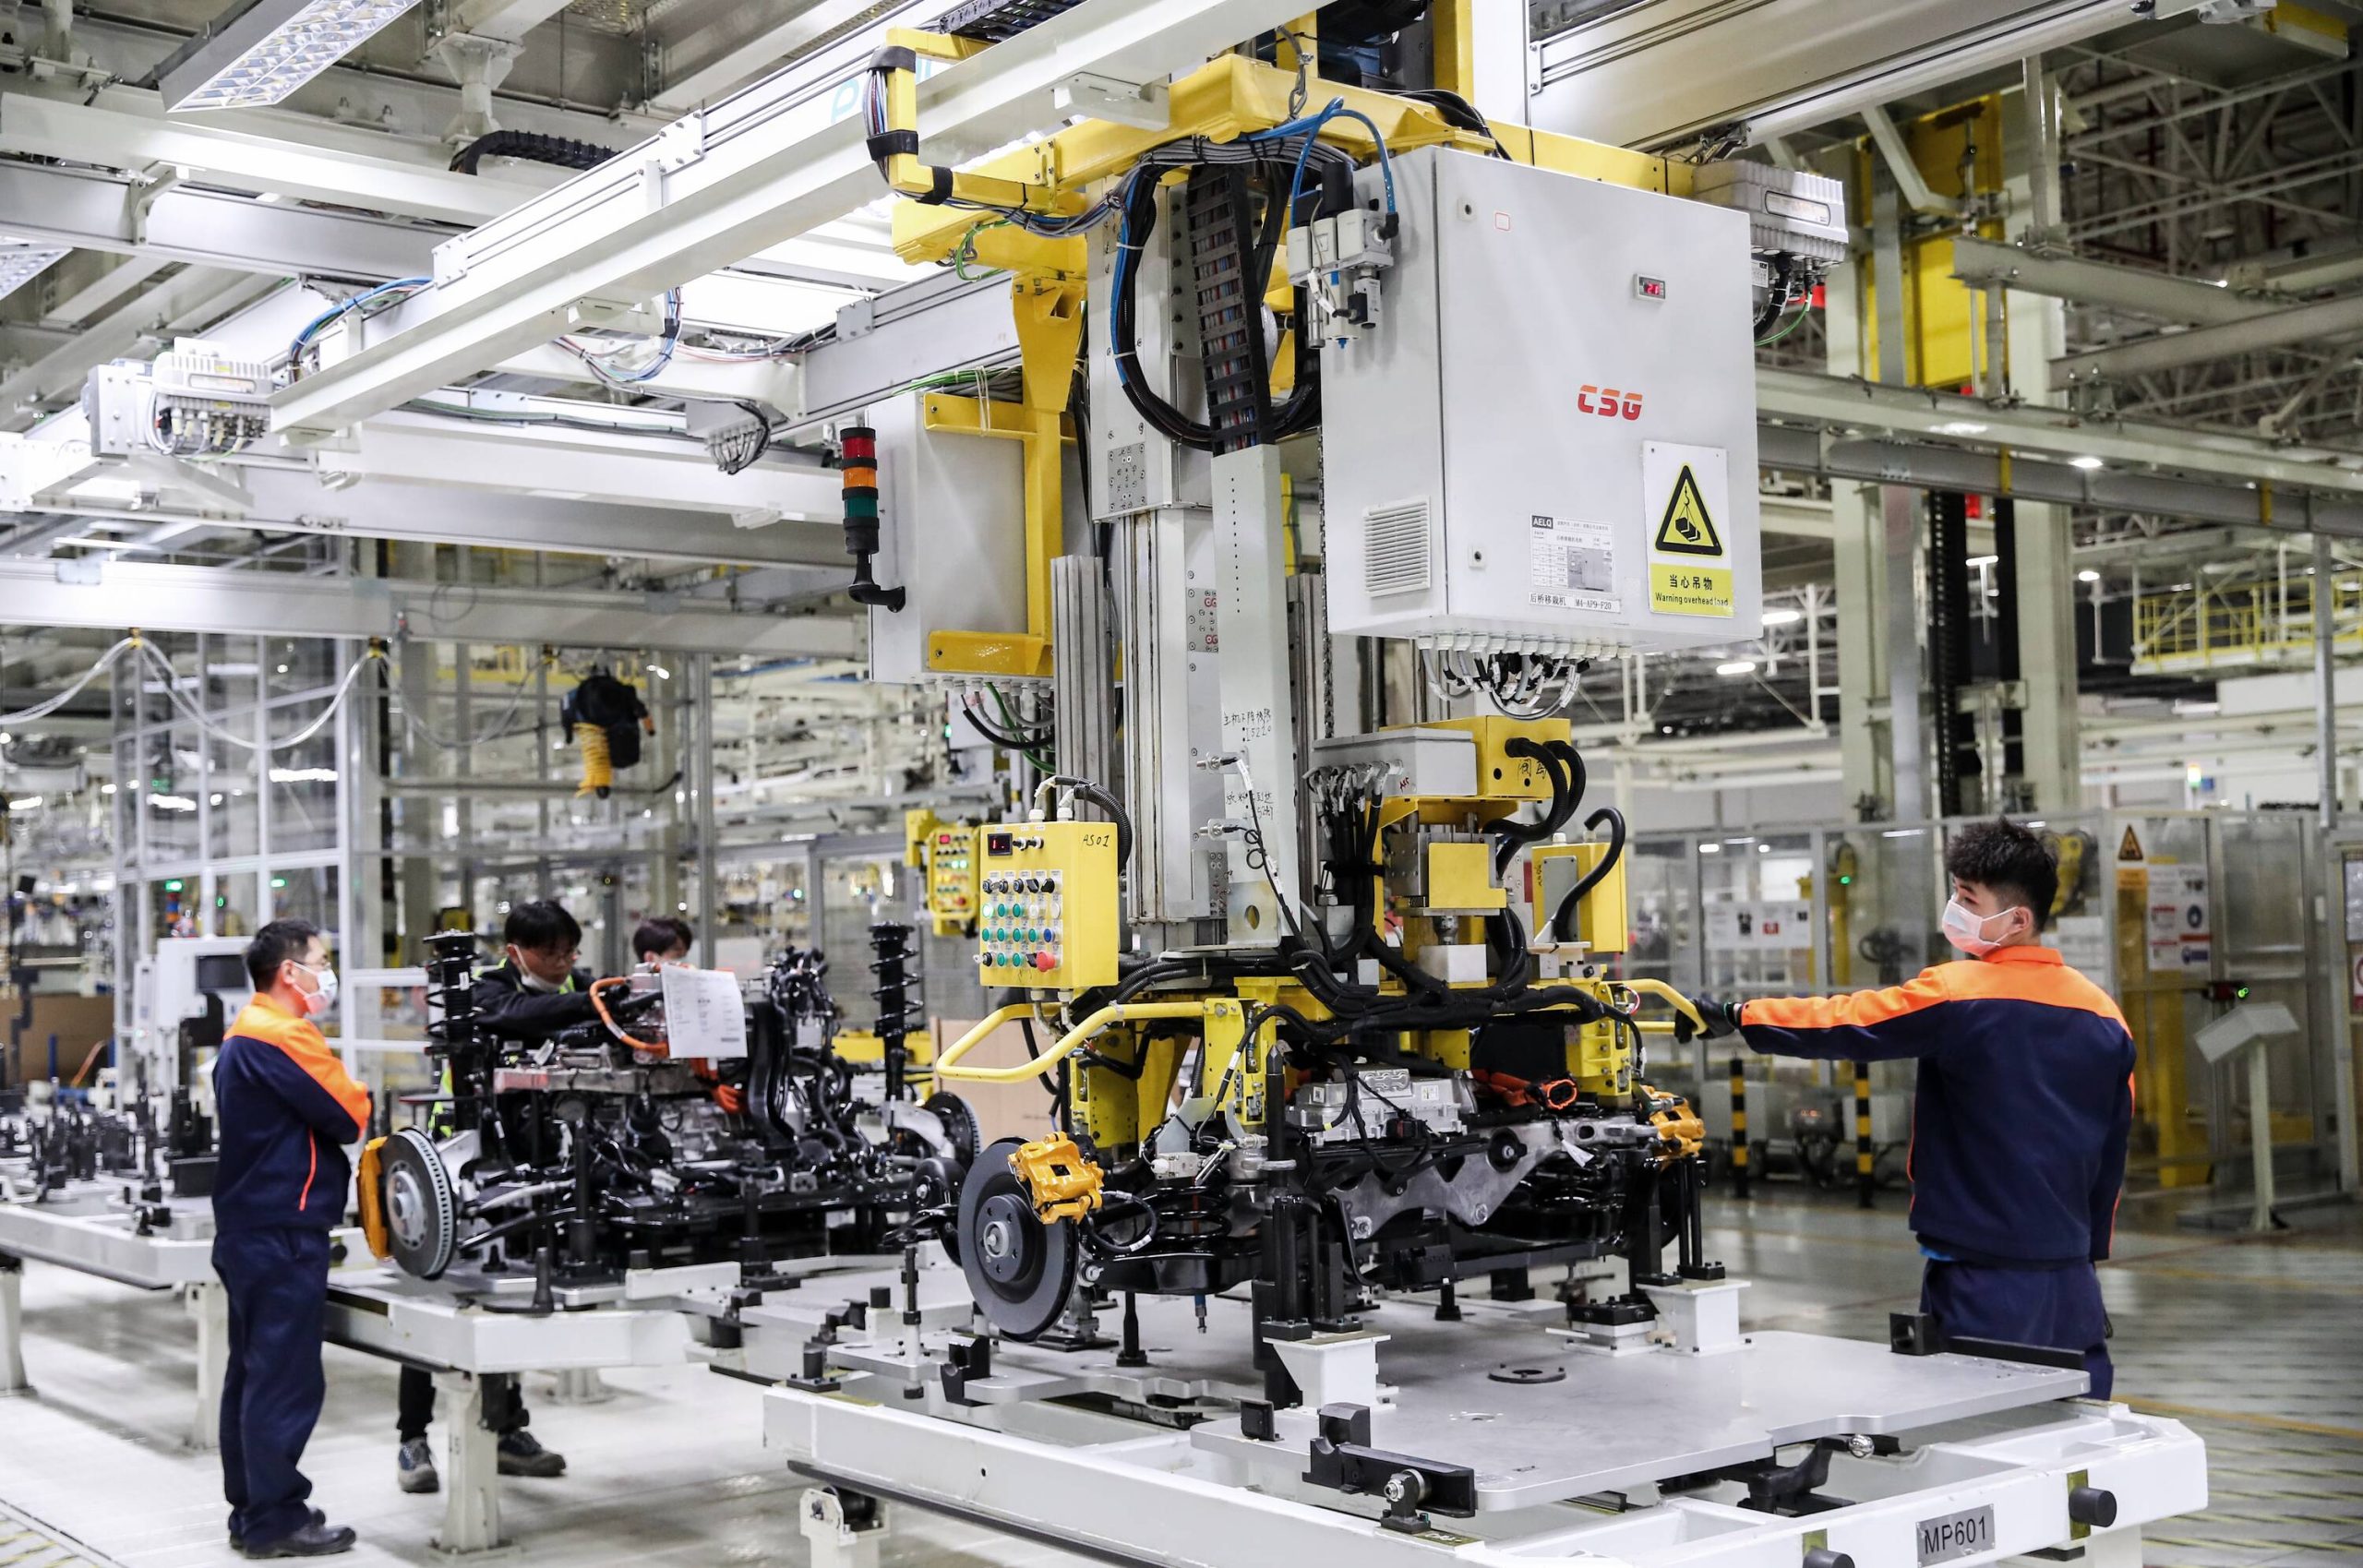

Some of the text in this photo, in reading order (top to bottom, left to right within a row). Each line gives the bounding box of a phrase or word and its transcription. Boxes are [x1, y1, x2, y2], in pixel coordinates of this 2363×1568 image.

[1577, 384, 1643, 421] CSG
[1669, 574, 1713, 591] 当心吊物
[1575, 599, 1612, 610] M4-AP9-F20
[1655, 592, 1729, 606] Warning overhead load
[1924, 1515, 1985, 1554] MP601
